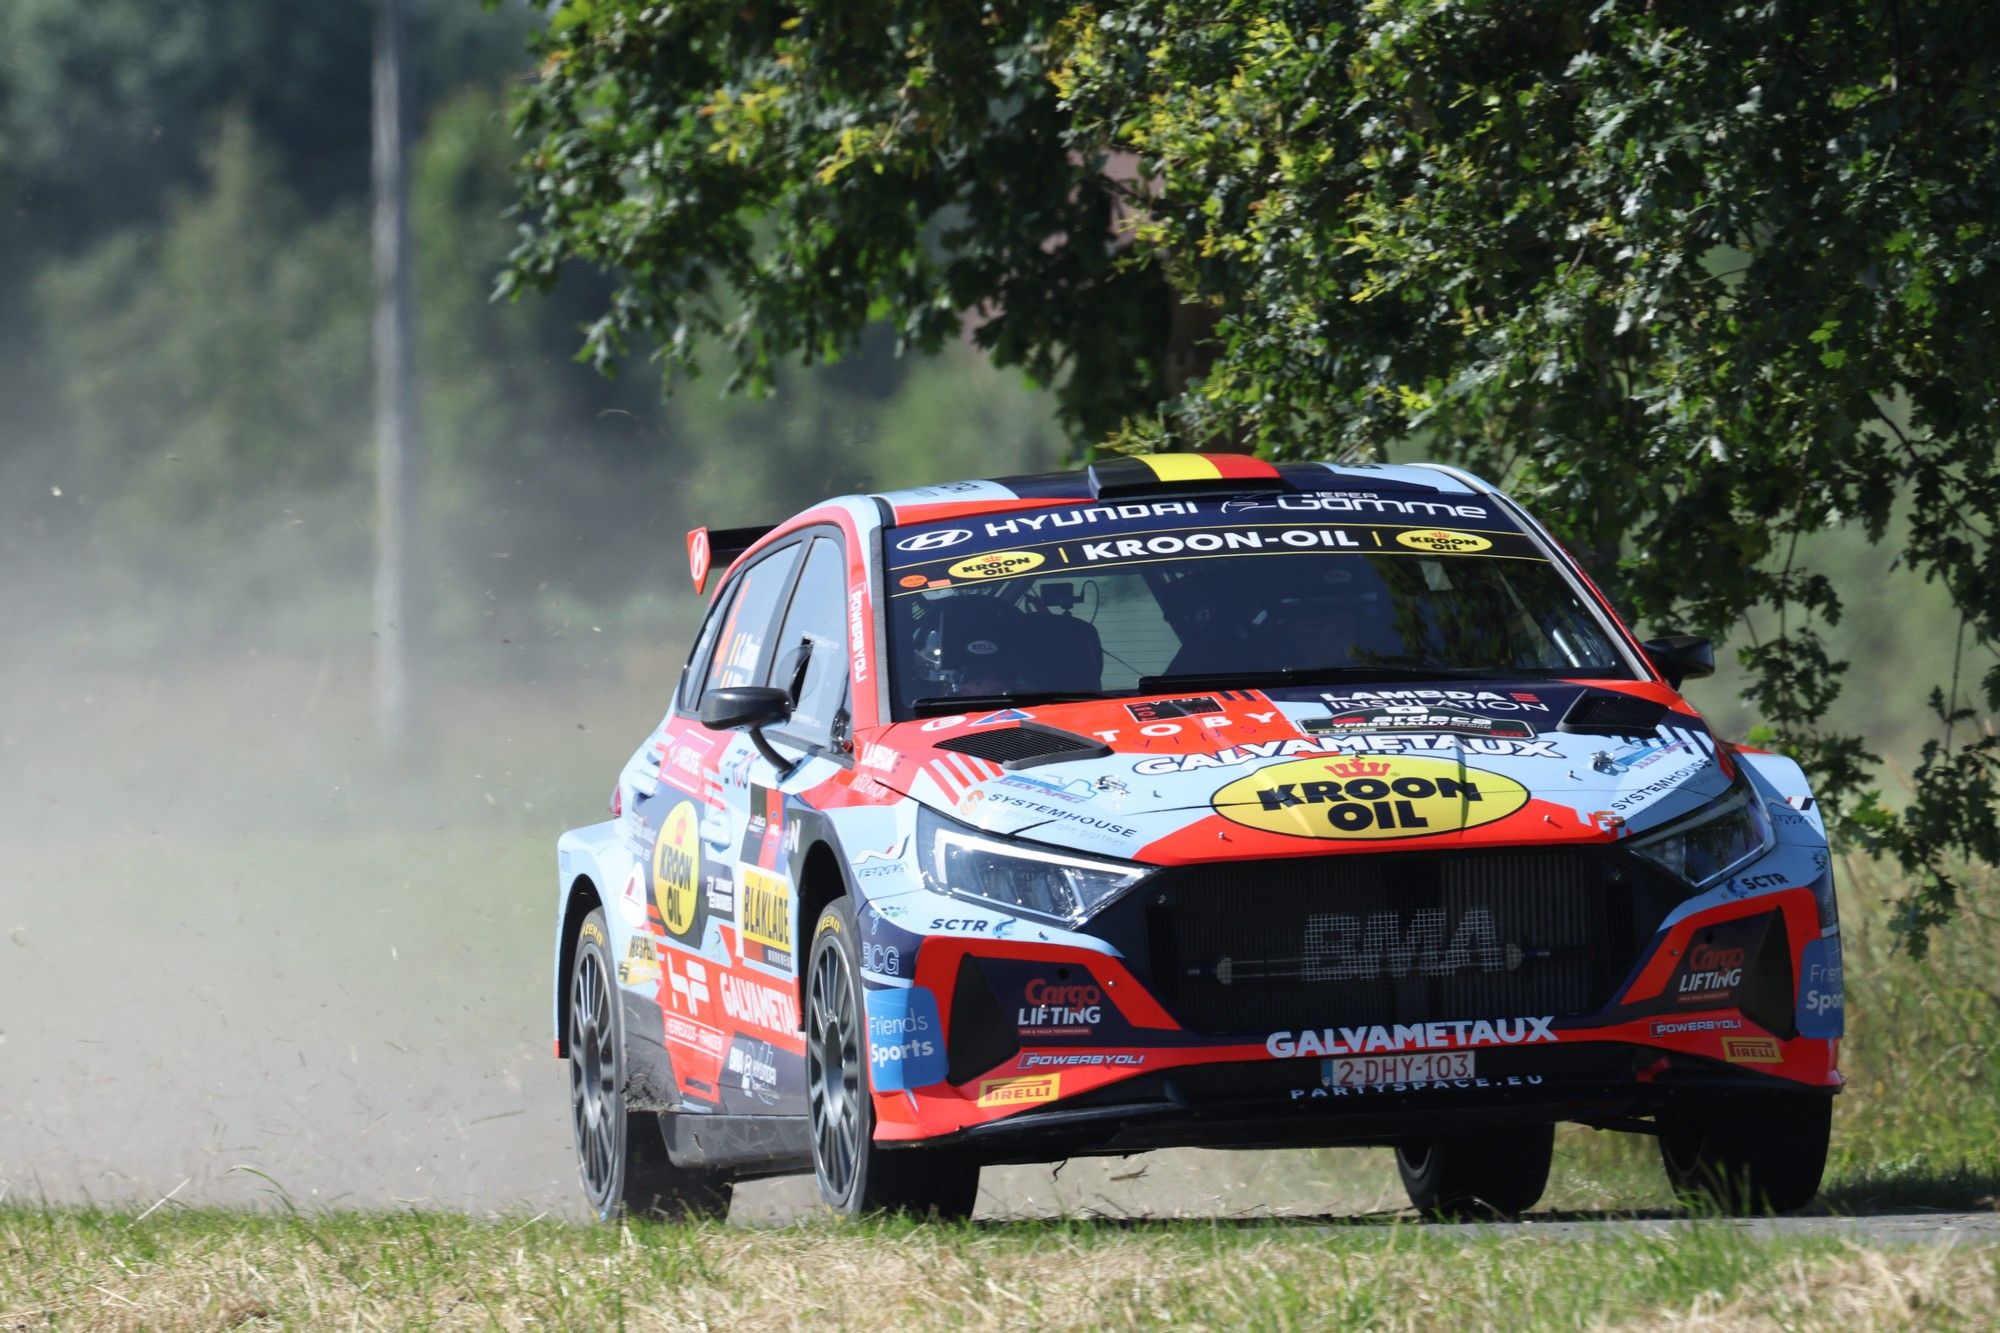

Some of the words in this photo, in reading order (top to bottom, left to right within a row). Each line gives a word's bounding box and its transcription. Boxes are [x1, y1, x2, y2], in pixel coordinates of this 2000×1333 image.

[984, 501, 1198, 537] HYUNDAI
[1083, 530, 1359, 560] KROON-OIL
[1409, 537, 1478, 545] KROON
[962, 556, 1030, 573] KROON
[983, 567, 1013, 576] OIL
[1320, 690, 1507, 701] LAMBDA
[1330, 699, 1549, 711] INSULATION
[1094, 712, 1276, 742] TOBY
[1133, 734, 1566, 775] GALVAMETAUX
[1257, 777, 1483, 811] KROON
[988, 794, 1137, 838] SYSTEMHOUSE
[1328, 801, 1429, 831] OIL
[659, 844, 692, 891] KROON
[1746, 873, 1789, 890] SCTR
[667, 886, 682, 926] OIL
[930, 918, 988, 932] SCTR
[1689, 945, 1744, 970] Cargo
[1679, 969, 1742, 992] LIFTING
[1024, 978, 1100, 1013] Cargo
[869, 1006, 928, 1035] Friends
[1017, 1006, 1101, 1025] LIFTING
[1265, 1016, 1558, 1058] GALVAMETAUX
[1727, 1041, 1776, 1058] PIRELLI
[870, 1040, 934, 1068] Sports
[1339, 1053, 1469, 1086] 2-DHY-103
[985, 1079, 1052, 1101] PIRELLI
